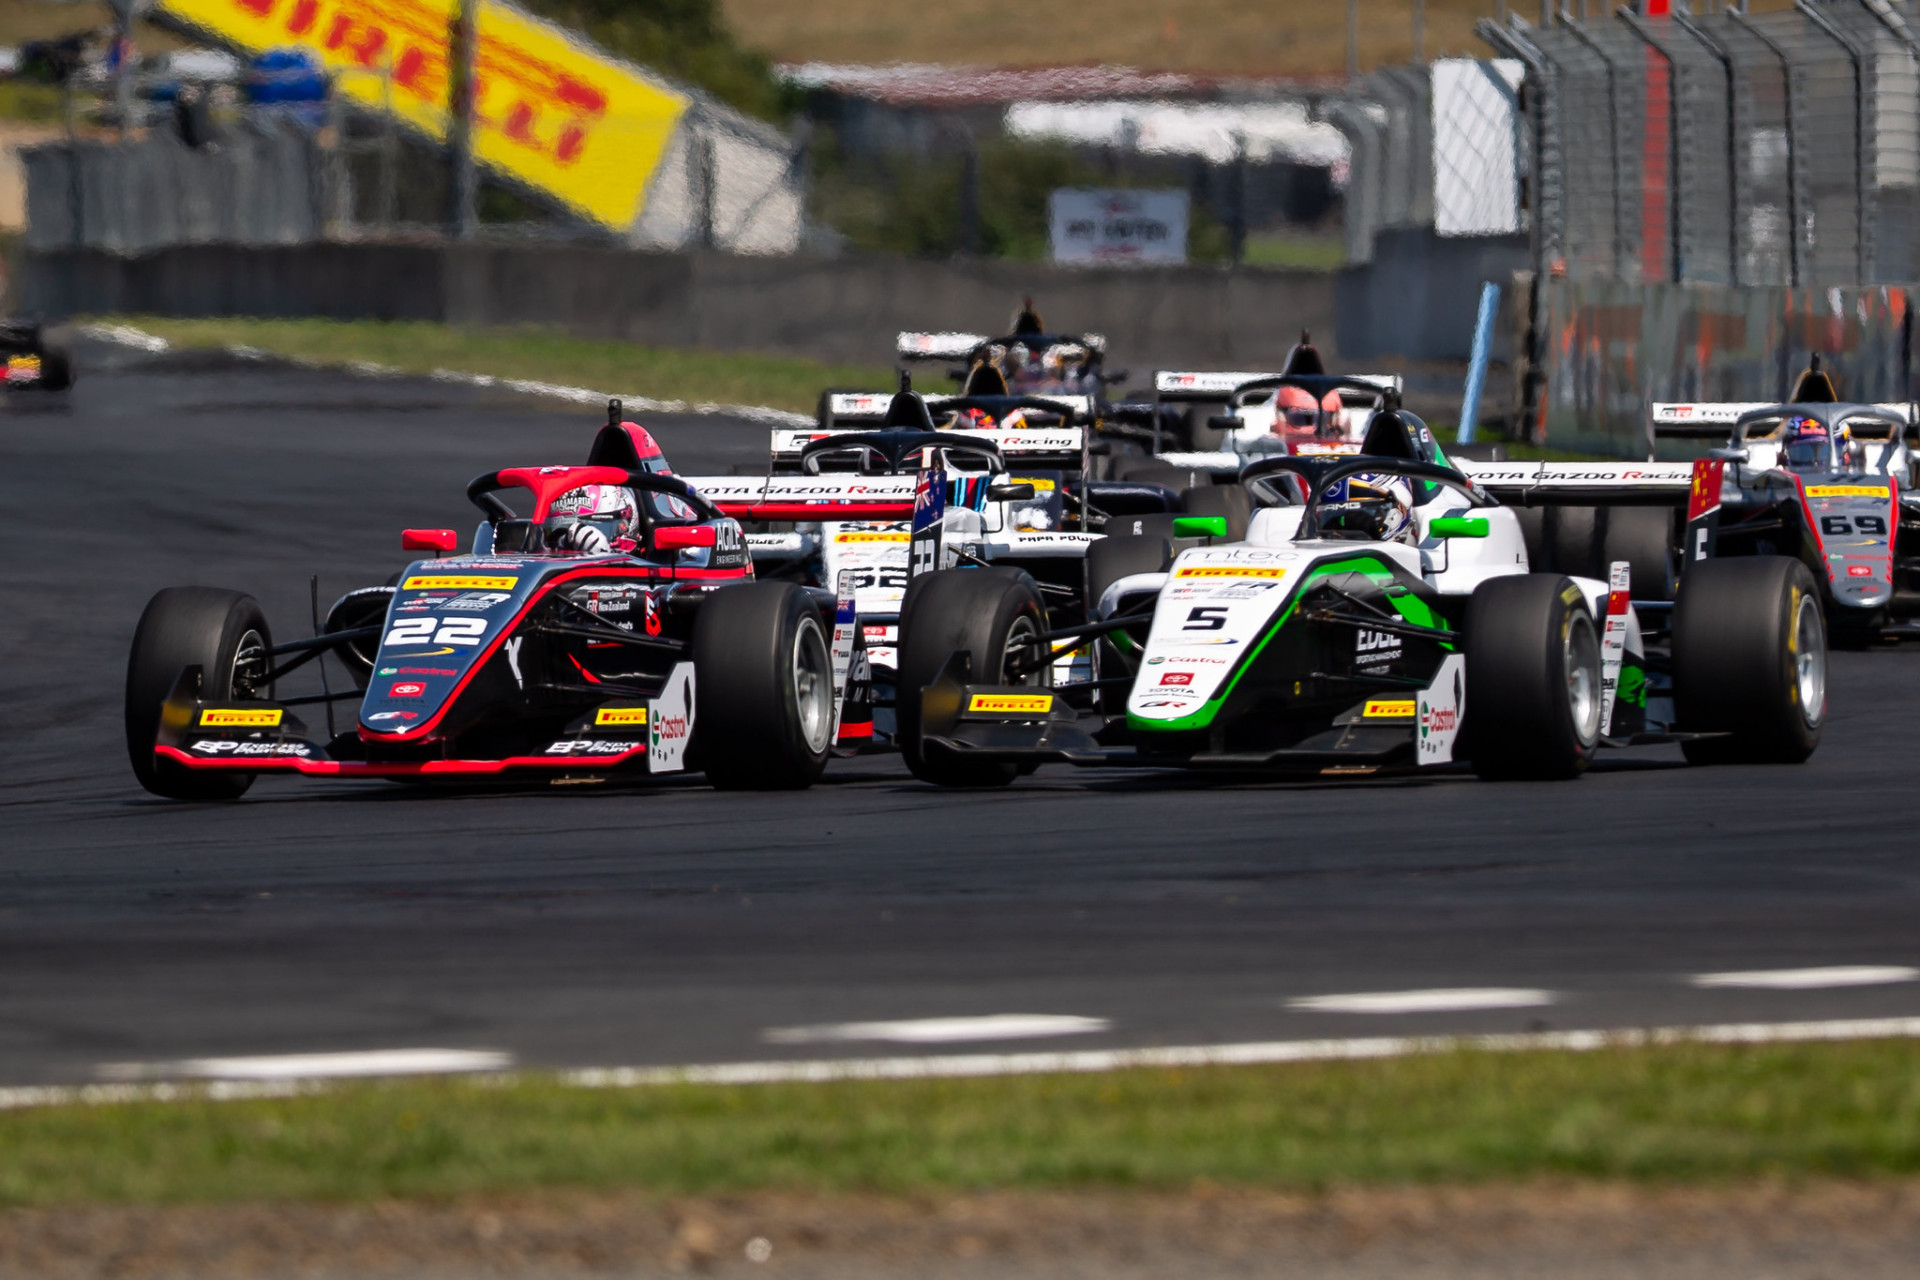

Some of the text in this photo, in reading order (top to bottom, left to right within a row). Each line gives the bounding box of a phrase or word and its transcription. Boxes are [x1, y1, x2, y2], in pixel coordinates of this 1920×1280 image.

[1003, 437, 1073, 447] Racing
[1464, 472, 1525, 480] YOTA
[1531, 471, 1618, 480] GAZOO
[756, 485, 842, 494] GAZOO
[1324, 502, 1361, 511] AMG
[1820, 515, 1887, 535] 69
[716, 521, 742, 551] AGILE
[1182, 606, 1229, 631] 5
[383, 617, 488, 646] 22
[1168, 656, 1226, 664] Castrol
[398, 666, 458, 676] Castrol
[976, 699, 1046, 709] PIRELLI
[1370, 704, 1416, 713] PIRE
[206, 713, 276, 723] PIRELLI
[602, 712, 647, 721] PIRE
[660, 713, 687, 740] Castrol
